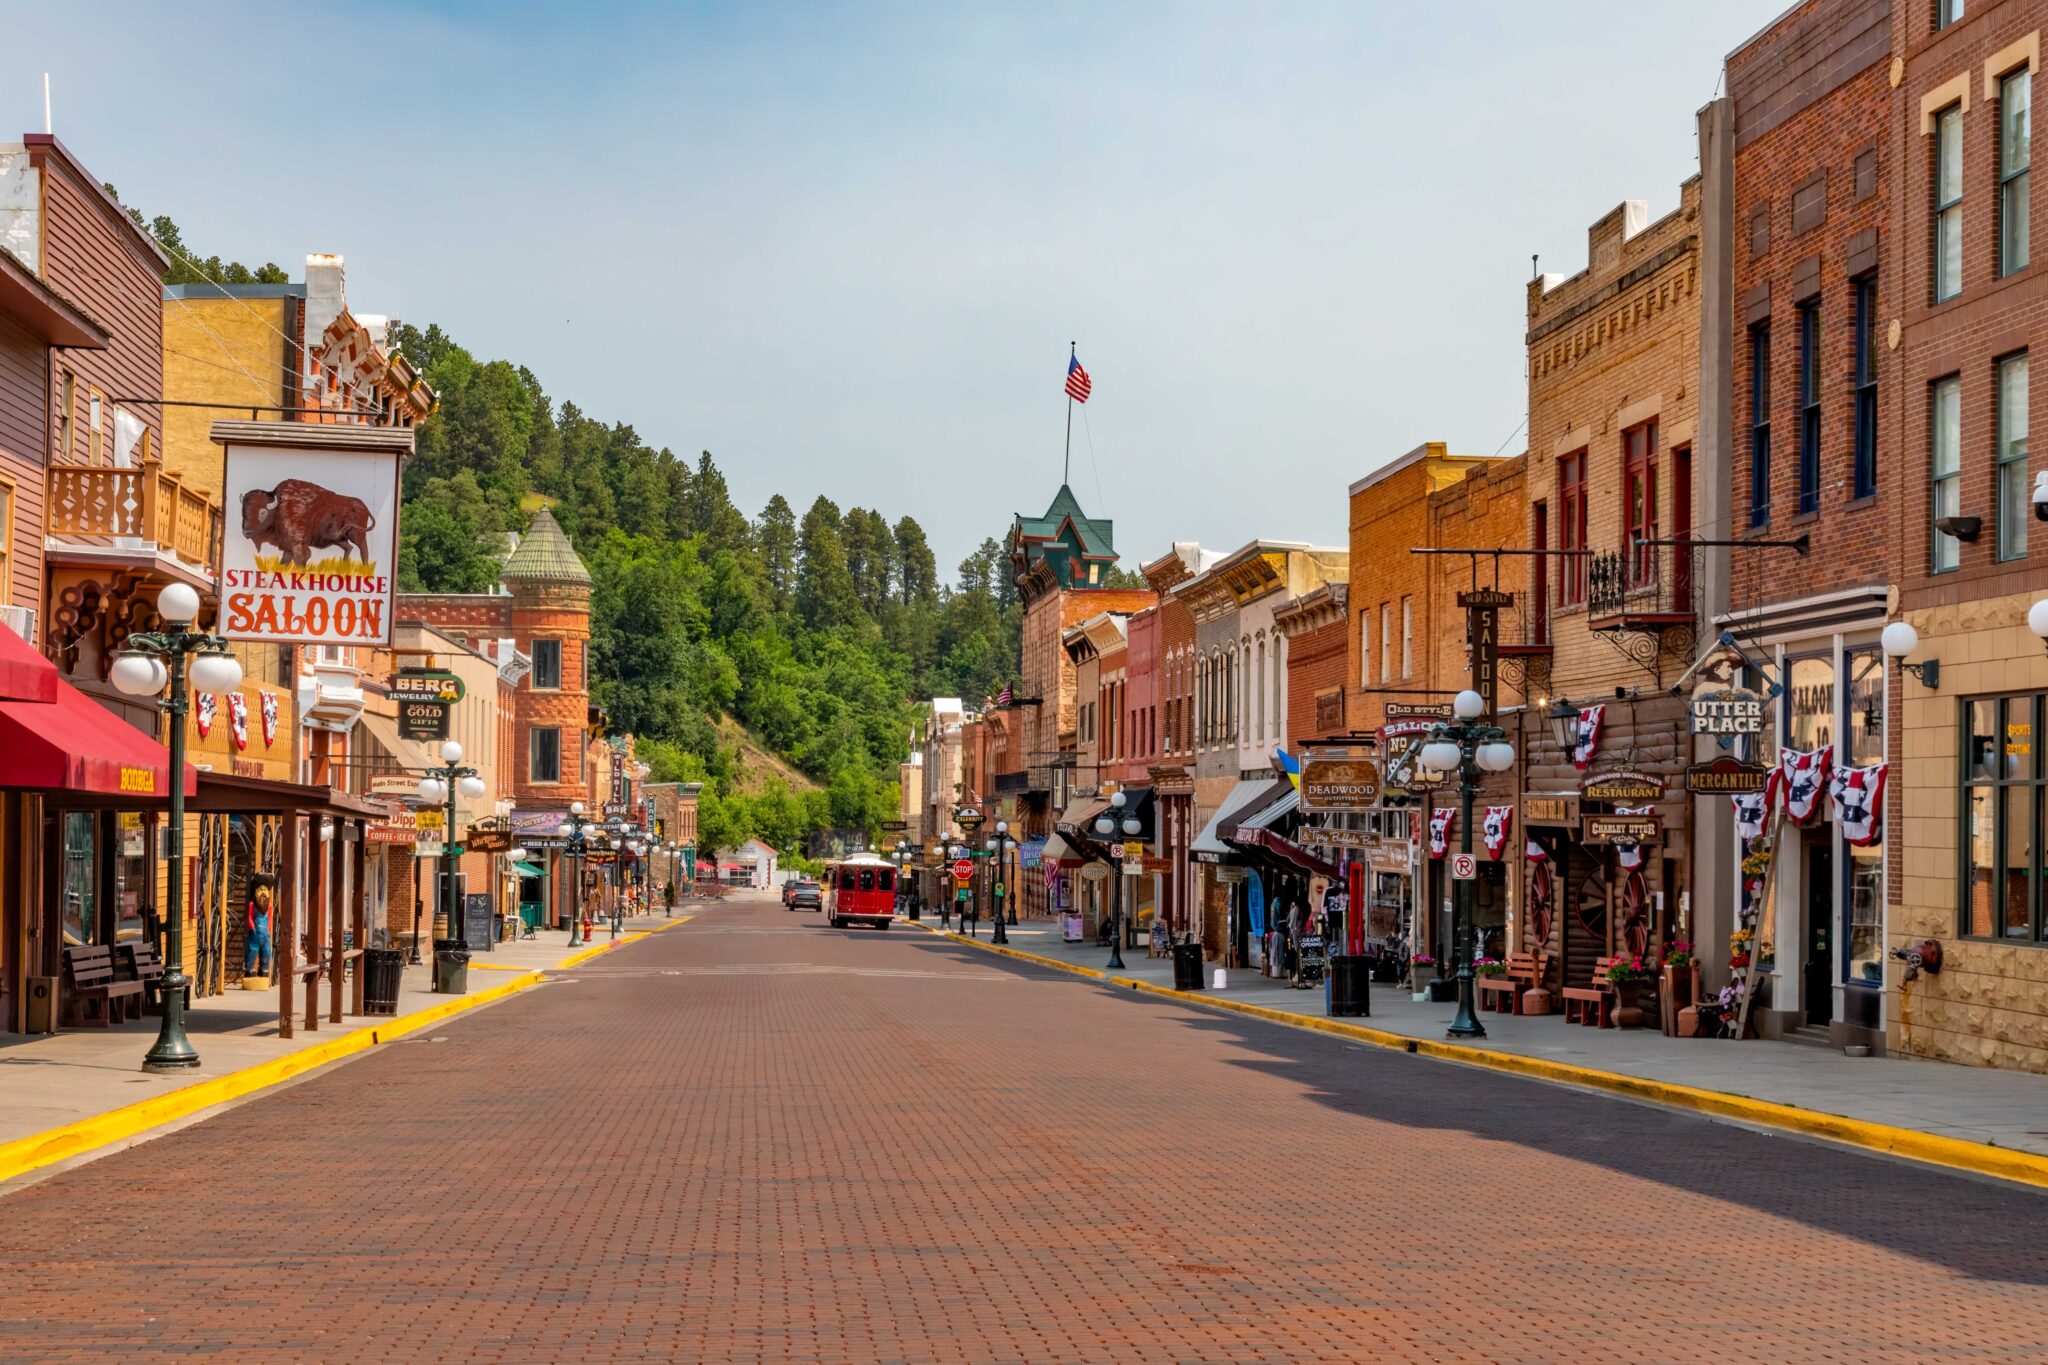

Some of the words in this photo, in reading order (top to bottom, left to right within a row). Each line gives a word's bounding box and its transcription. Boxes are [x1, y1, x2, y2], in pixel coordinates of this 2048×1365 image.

[225, 569, 388, 594] STEAKHOUSE
[225, 592, 384, 639] SALOON
[1481, 610, 1491, 716] SALOON
[396, 678, 456, 692] BERG
[389, 692, 435, 700] JEWELRY
[407, 708, 442, 717] GOLD
[1387, 705, 1411, 714] OLD
[1414, 705, 1452, 715] STYLE
[1694, 701, 1761, 717] UTTER
[1694, 717, 1761, 733] PLACE
[120, 767, 154, 792] BODEGA
[1690, 772, 1763, 788] MERCANTILE
[1308, 785, 1375, 794] DEADWOOD
[1587, 786, 1661, 798] RESTAURANT
[605, 805, 627, 814] BAR
[1591, 822, 1626, 834] CHARLEY
[1629, 823, 1656, 835] UTTER
[370, 832, 393, 840] COFFEE
[1302, 832, 1309, 840] &
[1309, 830, 1328, 845] Tipsy
[1329, 832, 1359, 844] Buffalo
[1360, 834, 1377, 846] Bar
